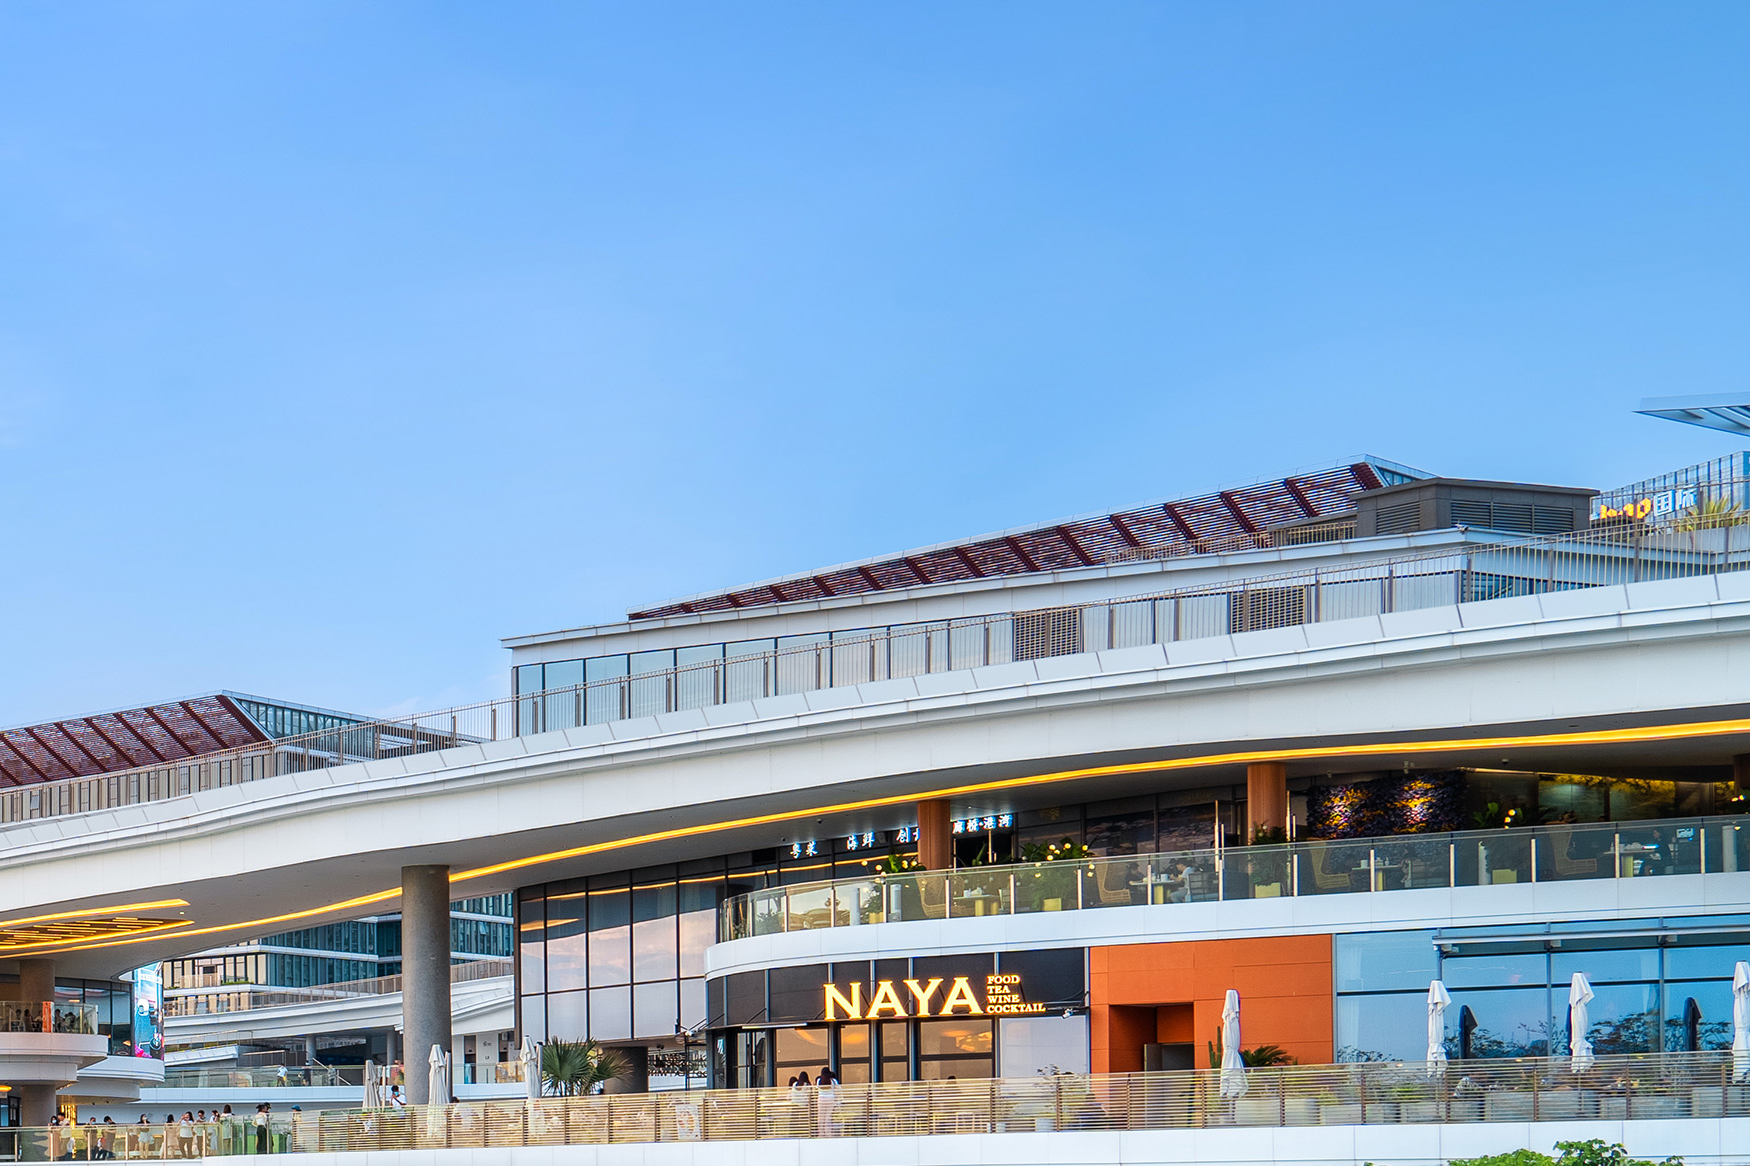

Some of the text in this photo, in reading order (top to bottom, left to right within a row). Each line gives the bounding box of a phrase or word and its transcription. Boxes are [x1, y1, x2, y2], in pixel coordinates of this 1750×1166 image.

[847, 831, 875, 851] 海鲜
[987, 974, 1020, 984] FOOD
[987, 985, 1010, 994] TEA
[823, 976, 984, 1021] NAYA
[987, 994, 1020, 1004] WINE
[986, 1003, 1046, 1014] COCKTAIL
